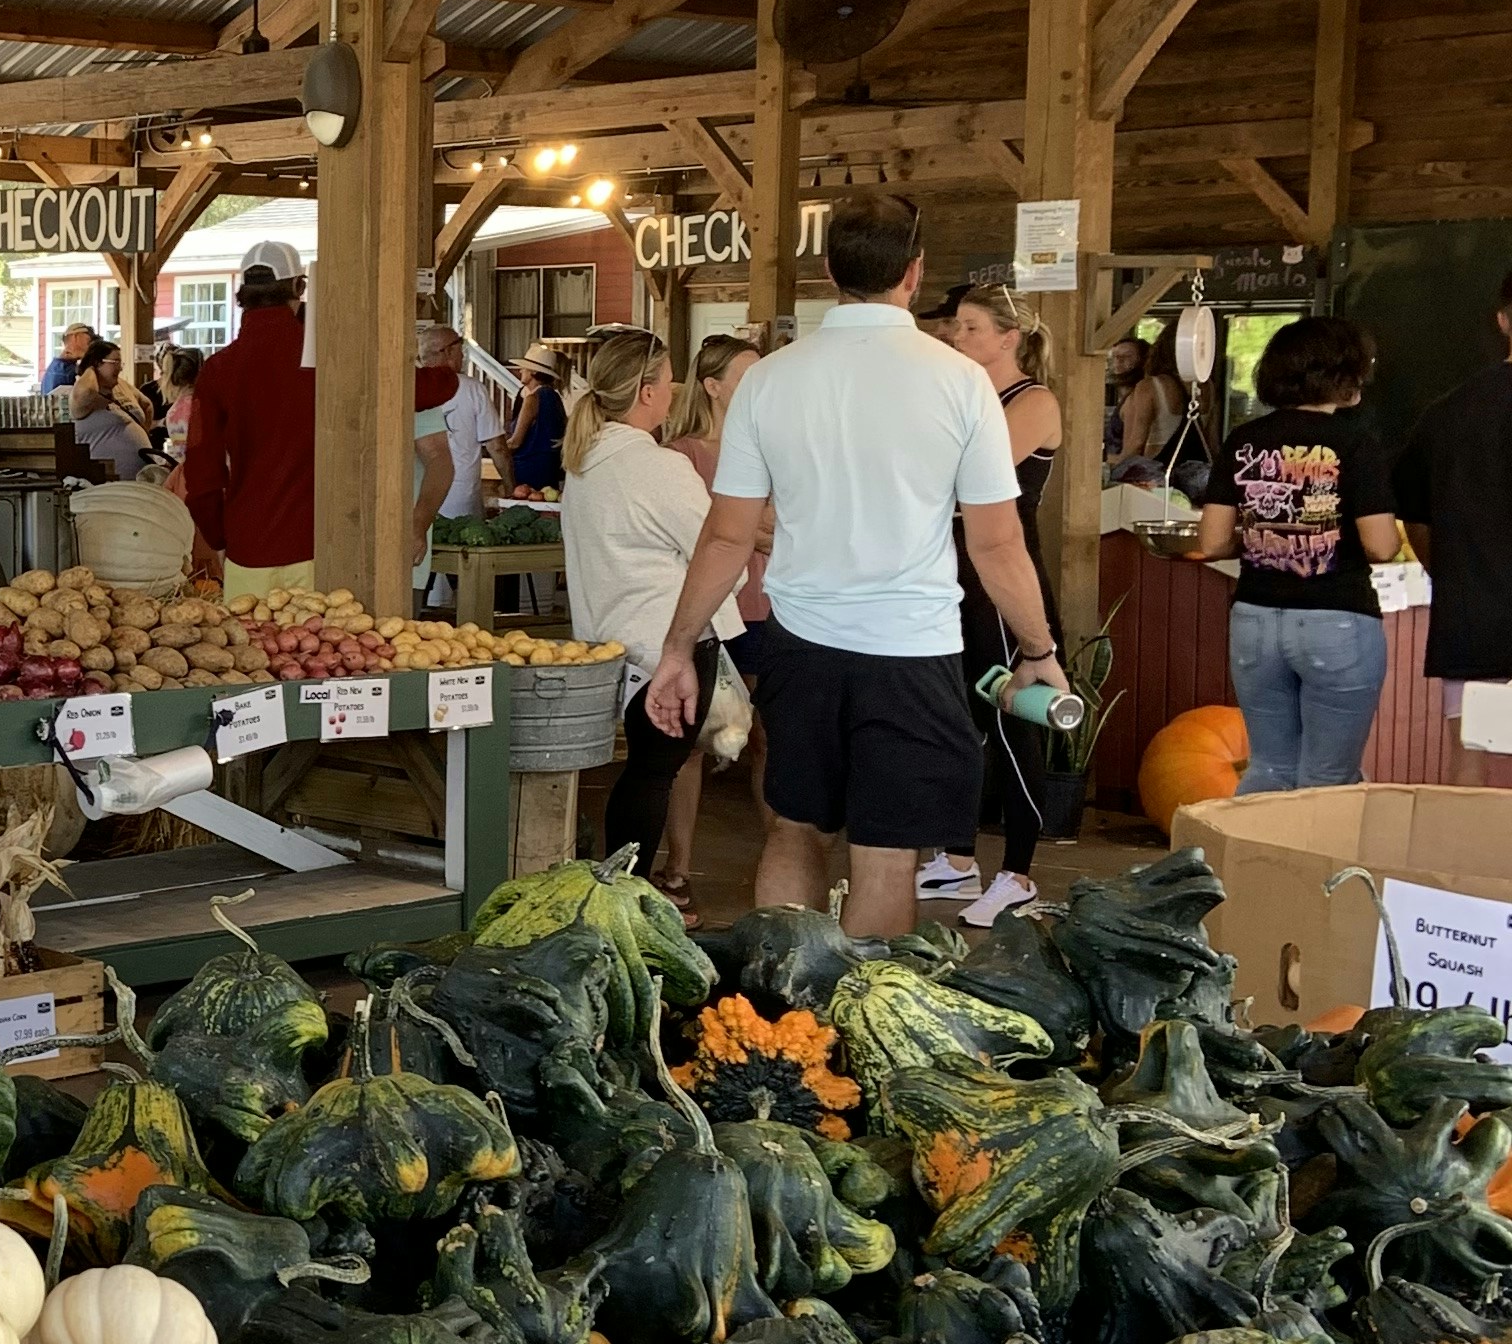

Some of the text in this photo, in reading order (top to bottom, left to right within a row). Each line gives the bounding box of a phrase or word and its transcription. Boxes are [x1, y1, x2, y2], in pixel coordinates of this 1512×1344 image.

[305, 689, 331, 700] Local
[81, 707, 101, 718] ONION
[334, 703, 364, 711] POTATOES
[1415, 917, 1498, 949] BUTTERNUT
[1427, 952, 1484, 978] SQUASH
[34, 1027, 50, 1038] each
